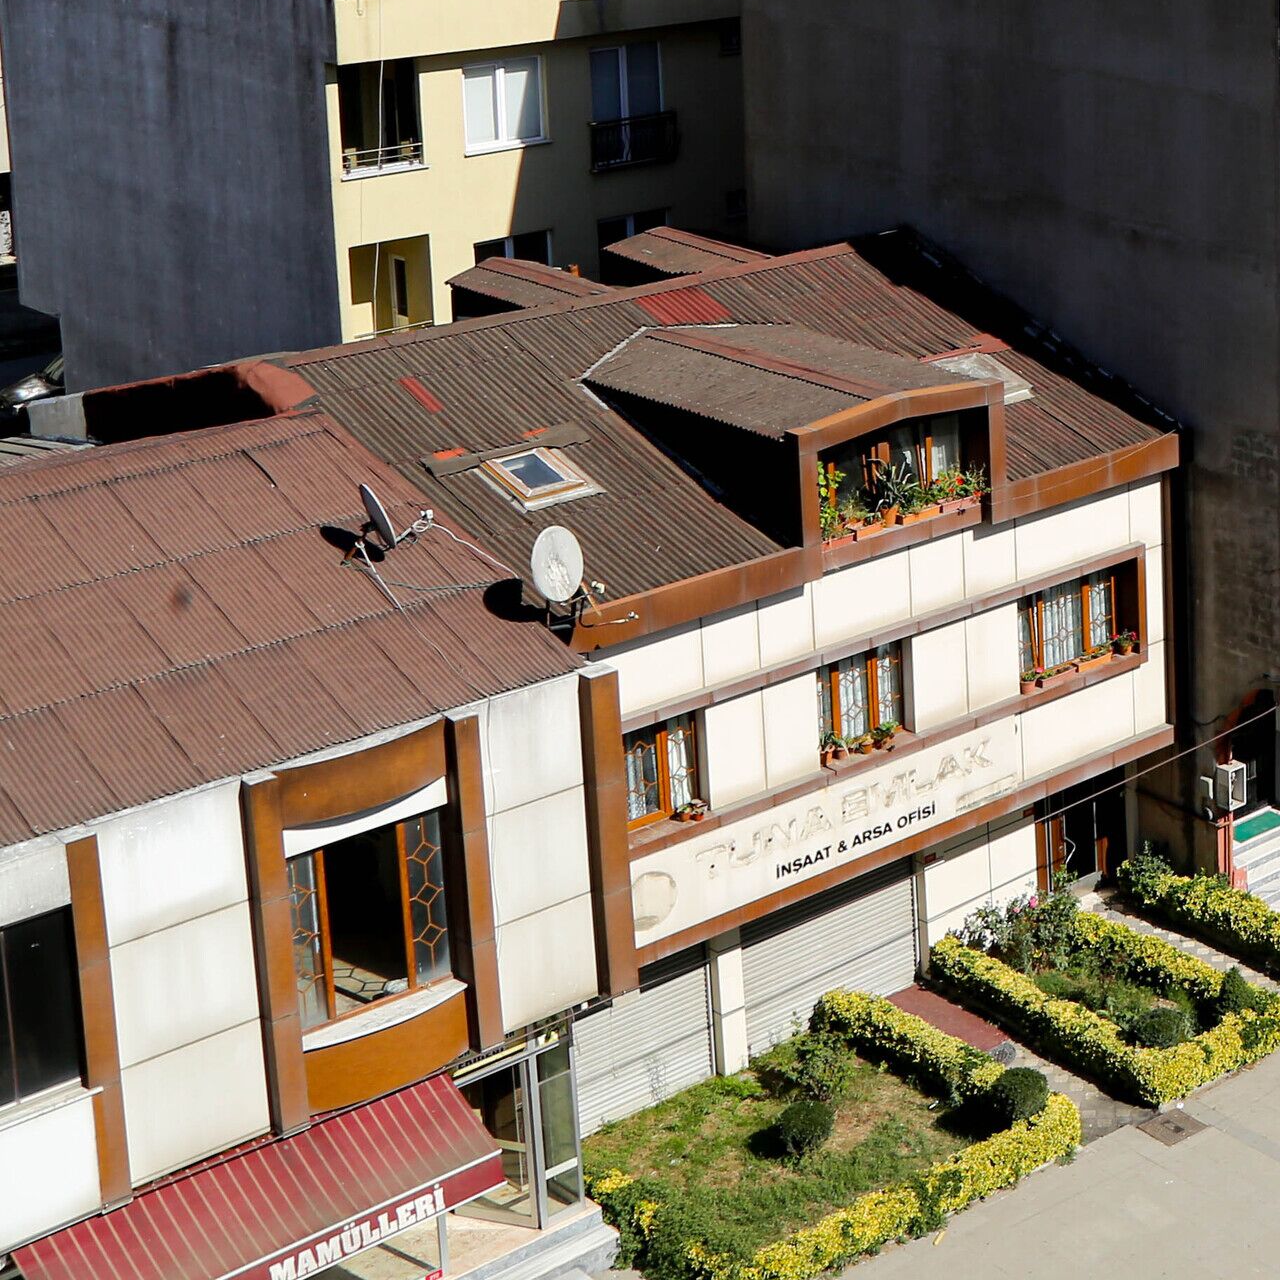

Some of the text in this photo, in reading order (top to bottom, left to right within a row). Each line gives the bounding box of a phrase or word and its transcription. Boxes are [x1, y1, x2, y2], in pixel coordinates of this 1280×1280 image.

[776, 800, 937, 881] İNŞAAT & ARSA OFİSİ
[268, 1183, 446, 1280] MAMÜLLERİ
